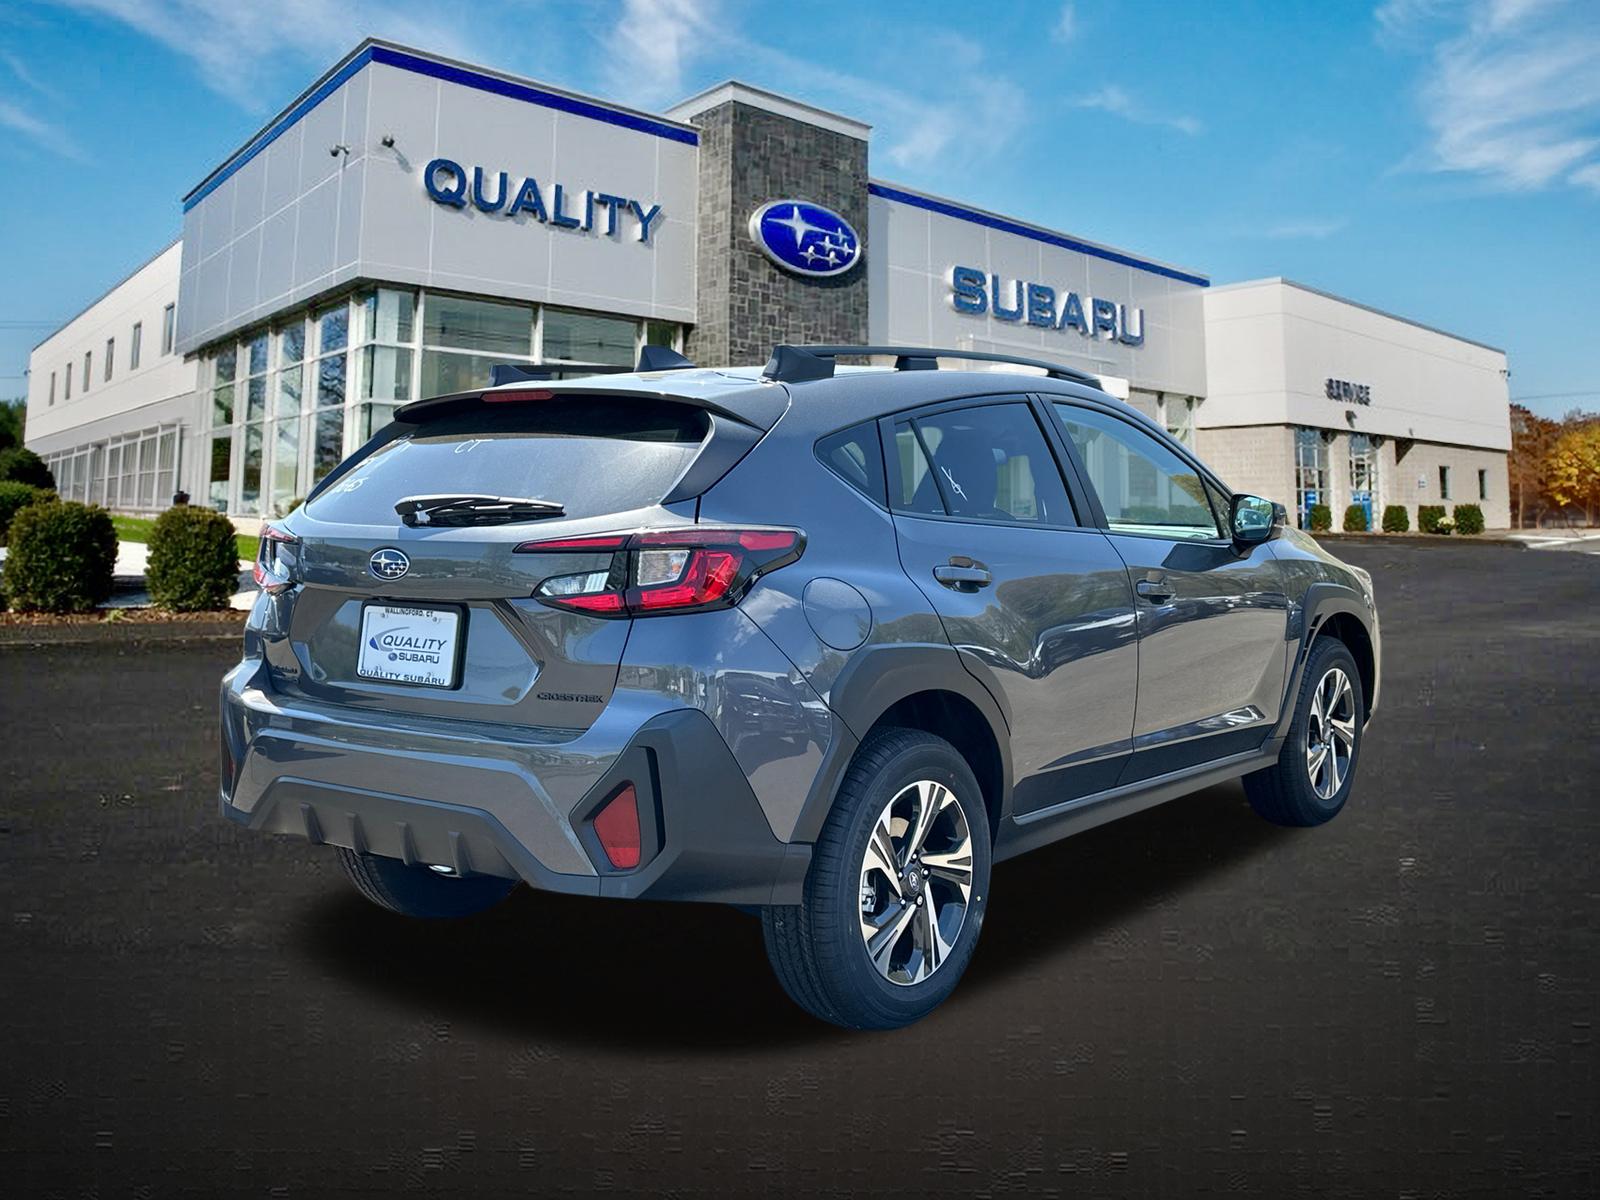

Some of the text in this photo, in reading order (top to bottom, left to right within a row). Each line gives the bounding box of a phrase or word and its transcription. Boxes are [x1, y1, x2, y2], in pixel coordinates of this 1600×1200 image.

[423, 158, 662, 243] QUALITY
[948, 265, 1145, 346] SUBARU
[1325, 378, 1371, 406] SERVICE
[383, 635, 447, 651] QUALITY
[398, 652, 440, 664] SUBARU
[359, 668, 446, 686] QUALITY SUBARU
[537, 692, 604, 703] CROSSTREK
